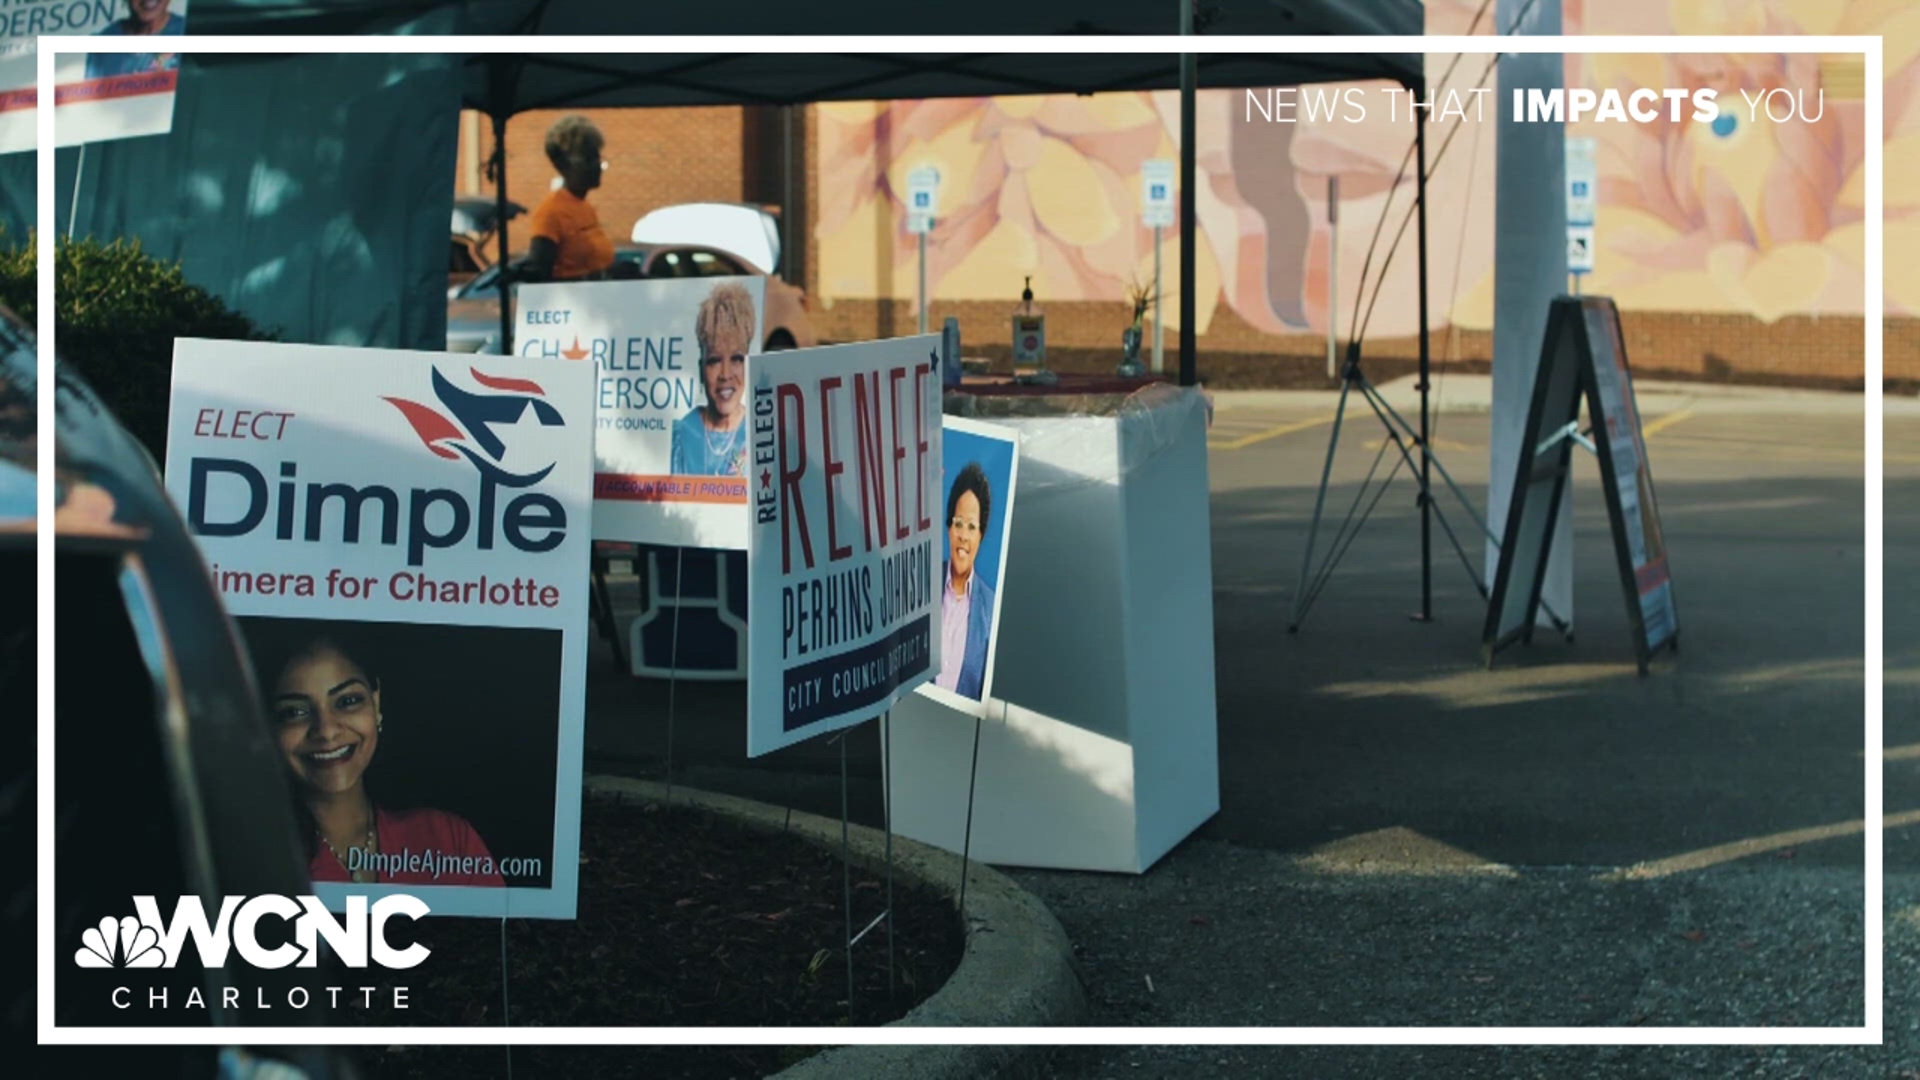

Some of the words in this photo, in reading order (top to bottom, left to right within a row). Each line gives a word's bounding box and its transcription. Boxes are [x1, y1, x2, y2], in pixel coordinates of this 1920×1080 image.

[526, 310, 571, 325] ELECT
[599, 377, 694, 410] ERSON
[193, 408, 295, 440] ELECT
[615, 416, 667, 430] COUNCIL
[776, 362, 931, 576] RENEE
[700, 482, 747, 496] PROVEN
[187, 456, 567, 566] Dimple
[325, 568, 378, 599] for
[388, 571, 560, 608] Charlotte
[782, 563, 872, 660] PERKINS
[880, 540, 931, 629] JOHNSON
[788, 677, 822, 712] CITY
[832, 657, 886, 698] COUNCIL
[348, 846, 542, 879] DimpleAjmera.com
